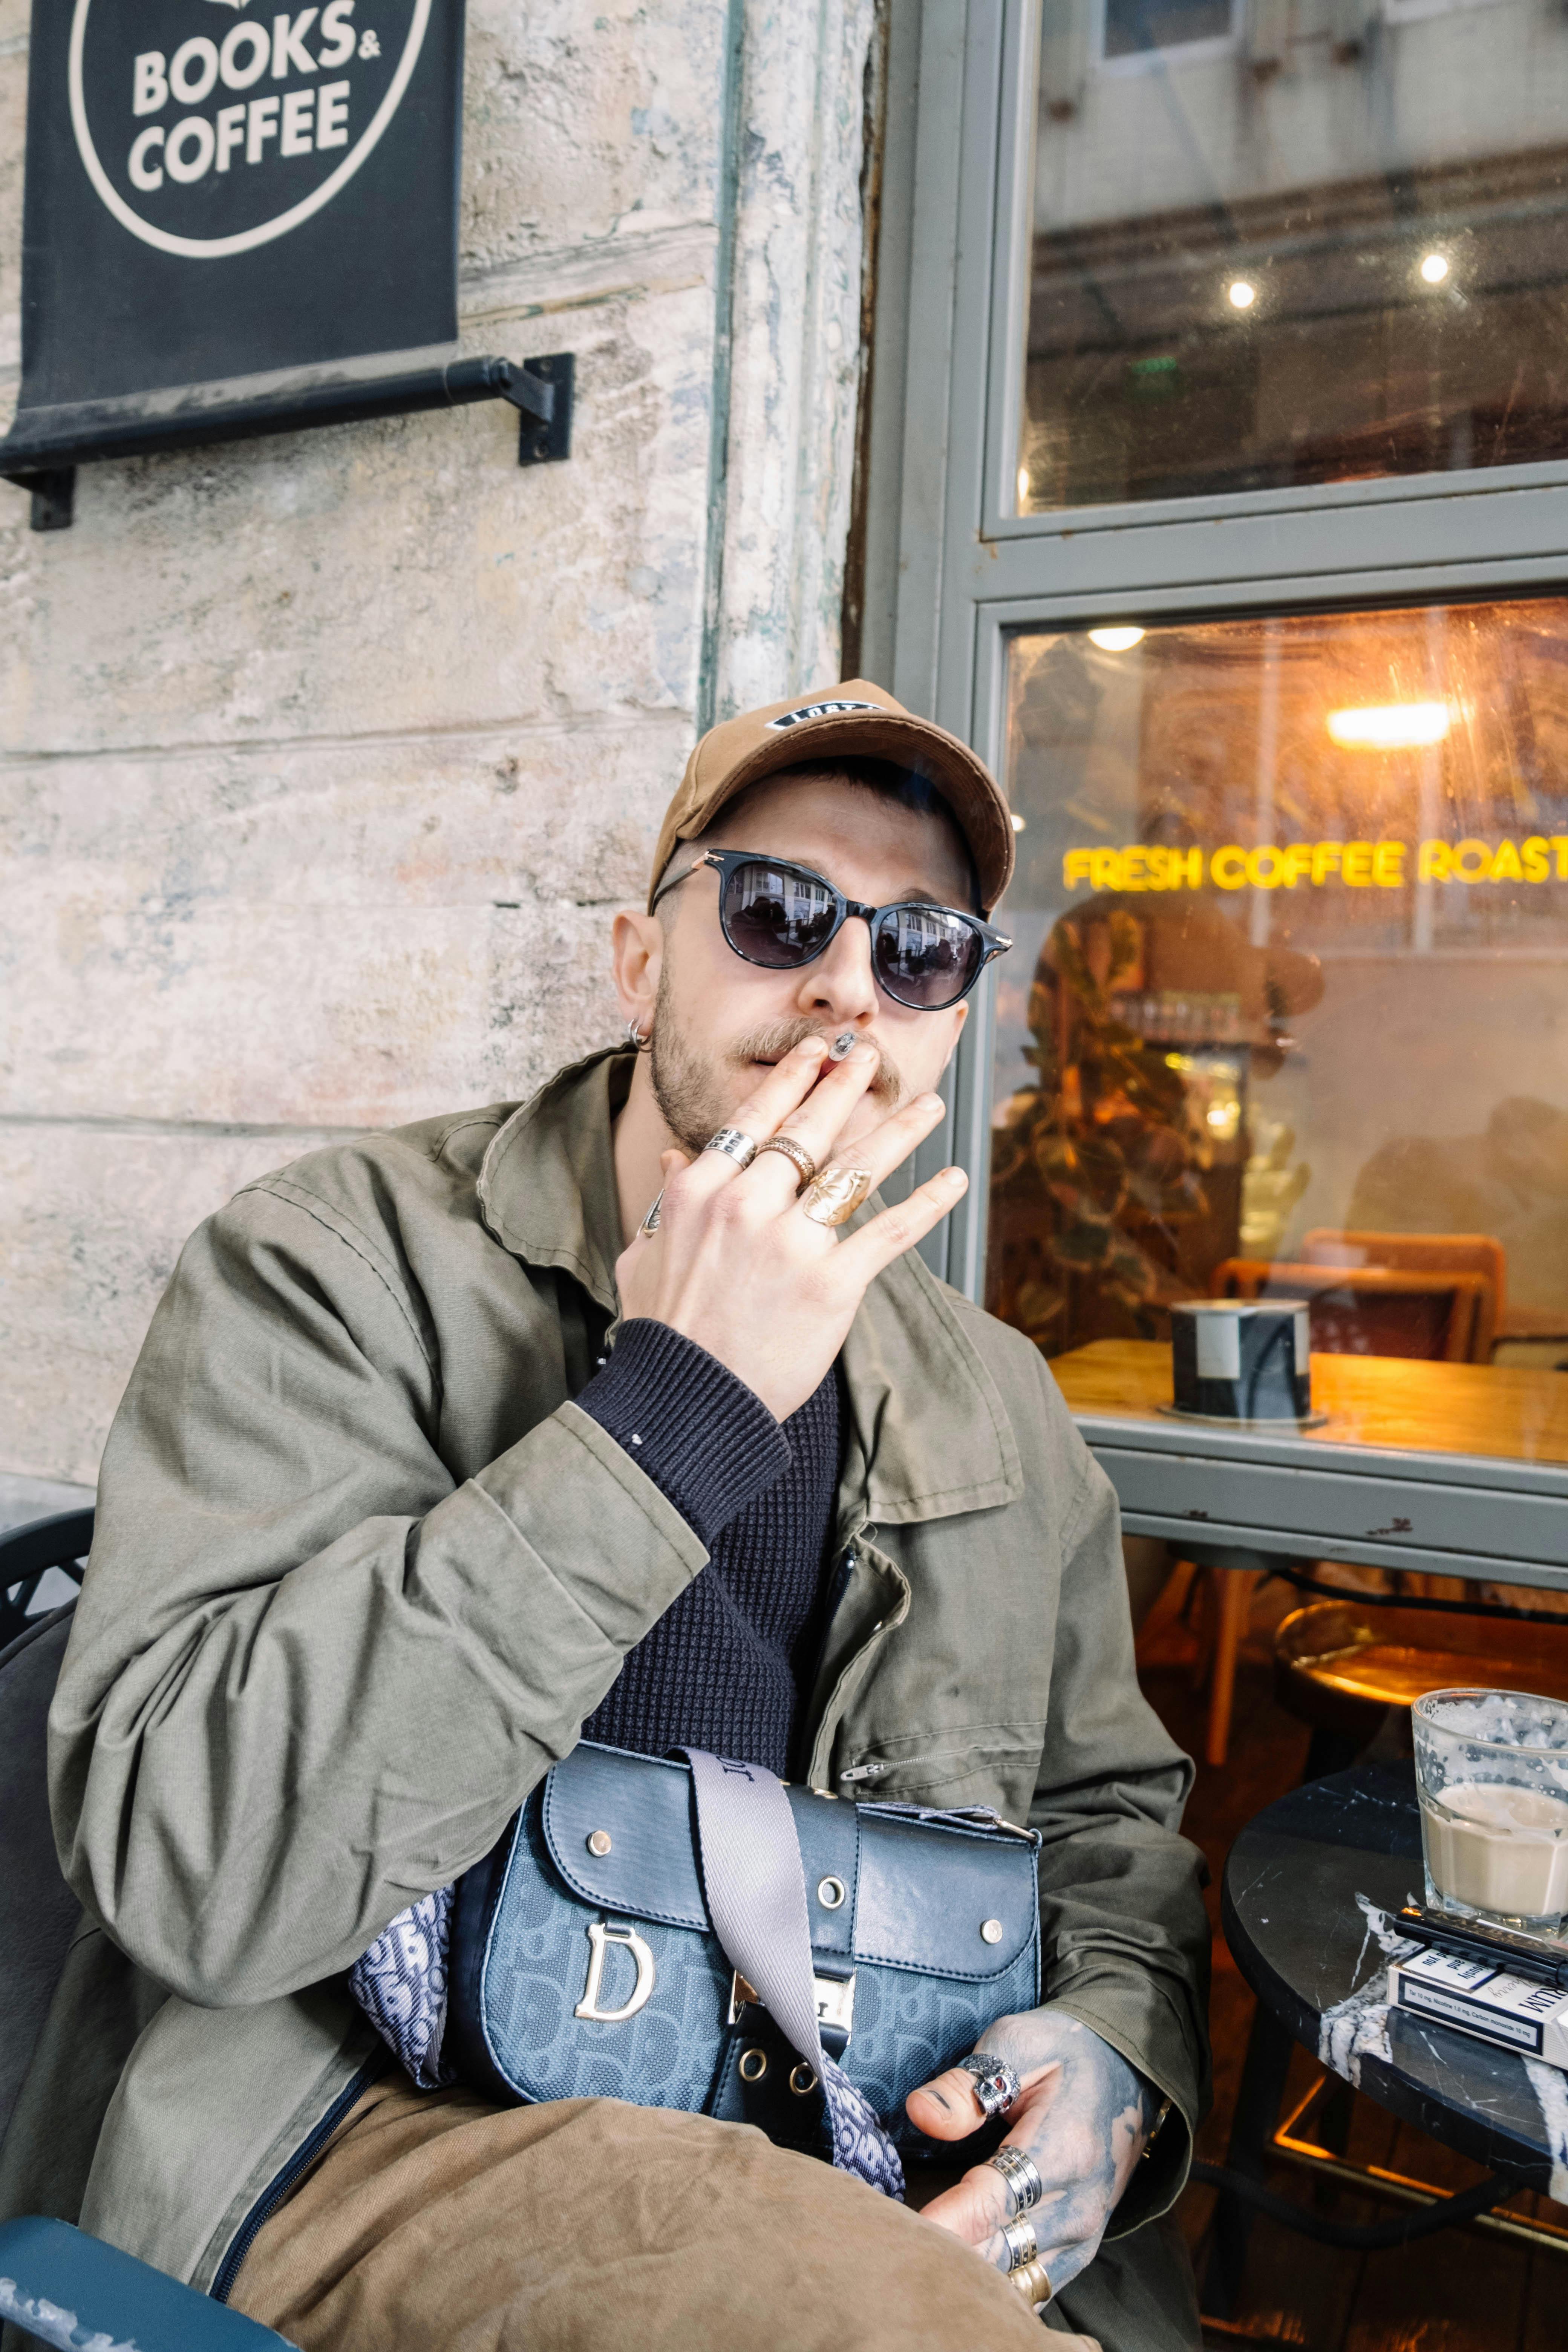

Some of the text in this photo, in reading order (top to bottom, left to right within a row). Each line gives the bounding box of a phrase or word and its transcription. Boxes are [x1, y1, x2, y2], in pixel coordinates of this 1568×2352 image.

[127, 80, 351, 191] COFFEE
[1063, 844, 1203, 891] FRESH
[1210, 841, 1407, 888] COFFEE
[574, 1922, 655, 2021] D
[1422, 1955, 1441, 1966] you
[1446, 1959, 1465, 1970] and
[1458, 1965, 1490, 1979] iously
[1433, 1998, 1453, 2009] Nicotine
[1472, 2012, 1489, 2022] Carbon
[1491, 2019, 1514, 2031] monoxide
[1518, 1988, 1568, 2013] RUM
